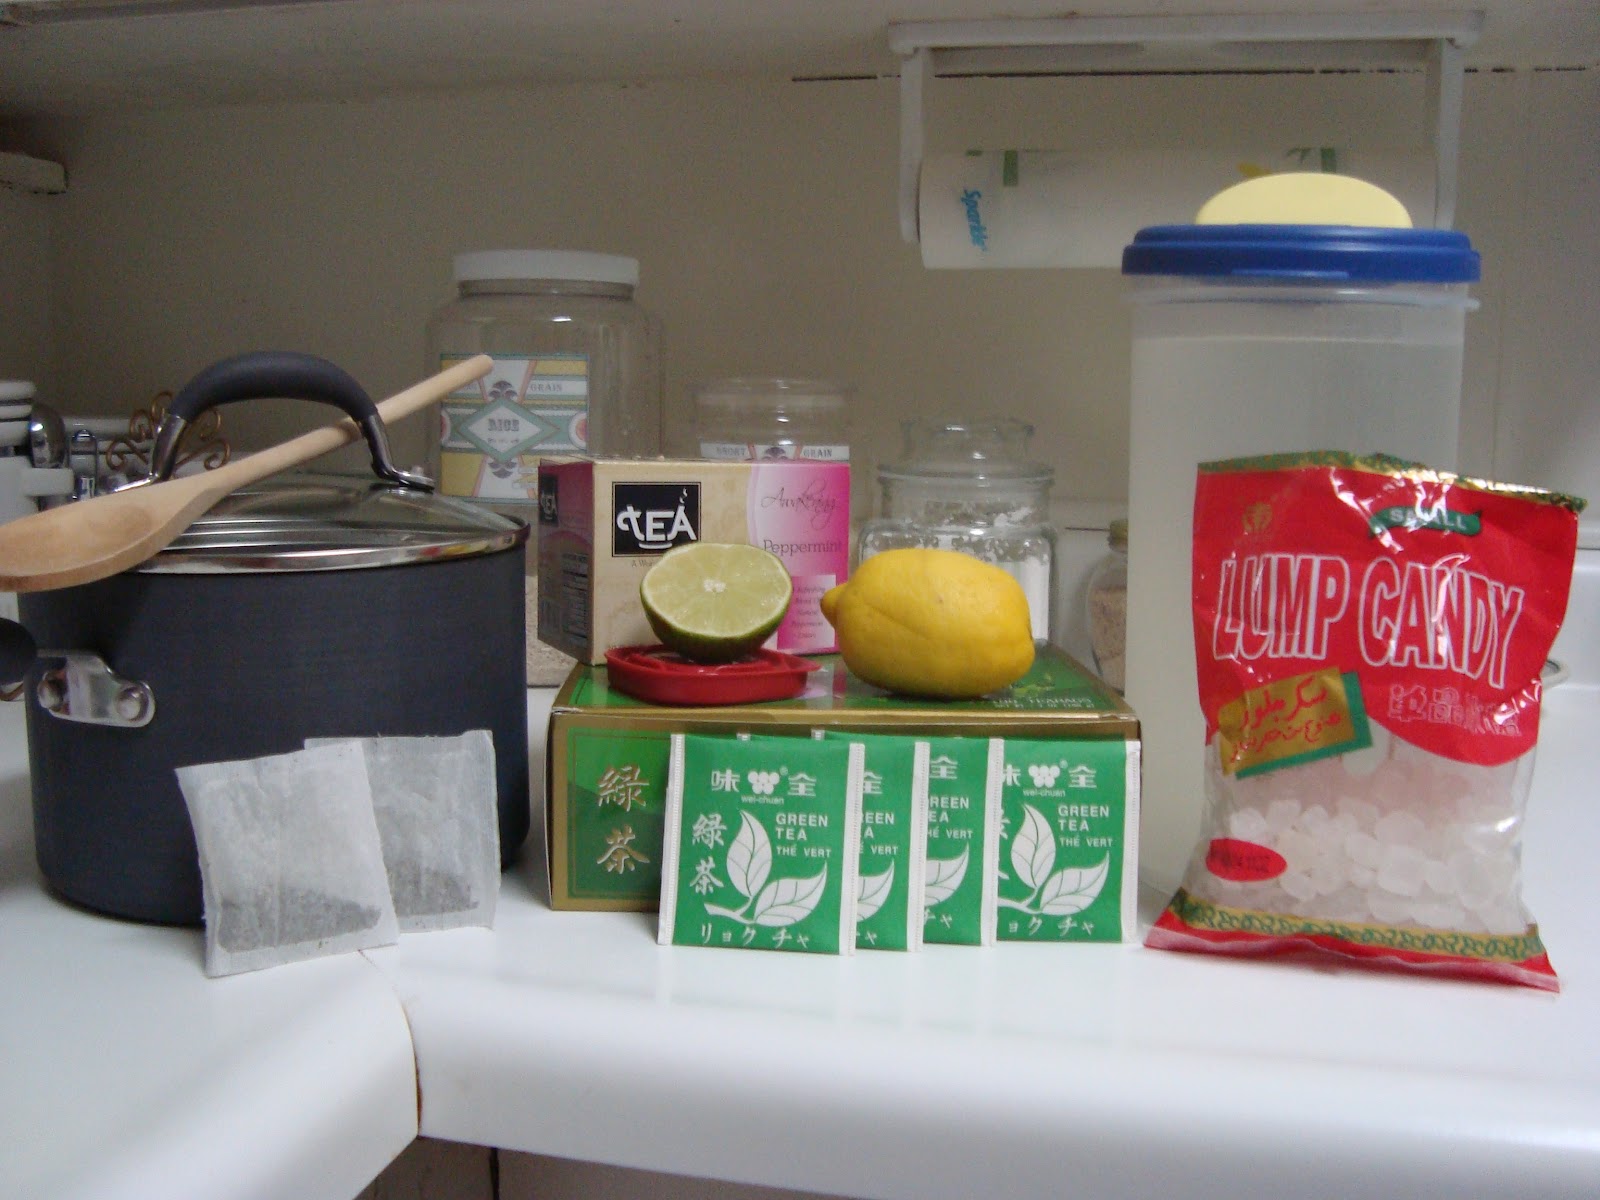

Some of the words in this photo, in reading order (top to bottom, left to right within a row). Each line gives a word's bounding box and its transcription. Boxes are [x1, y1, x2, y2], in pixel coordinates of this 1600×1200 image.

[763, 539, 842, 557] Peppermint
[1213, 553, 1350, 661] LUMP
[1358, 556, 1525, 689] CANDY
[711, 769, 740, 792] 味
[787, 773, 817, 797] 全
[1068, 765, 1097, 788] 全
[929, 796, 969, 809] REEN
[928, 810, 949, 822] EA
[1058, 805, 1110, 817] GREEN
[776, 812, 828, 827] GREEN
[863, 811, 895, 825] EEN
[1058, 819, 1090, 831] TEA
[776, 827, 807, 841] TEA
[946, 829, 973, 839] VERT
[1086, 838, 1113, 847] VERT
[803, 847, 832, 858] VERT
[870, 846, 898, 855] VERT
